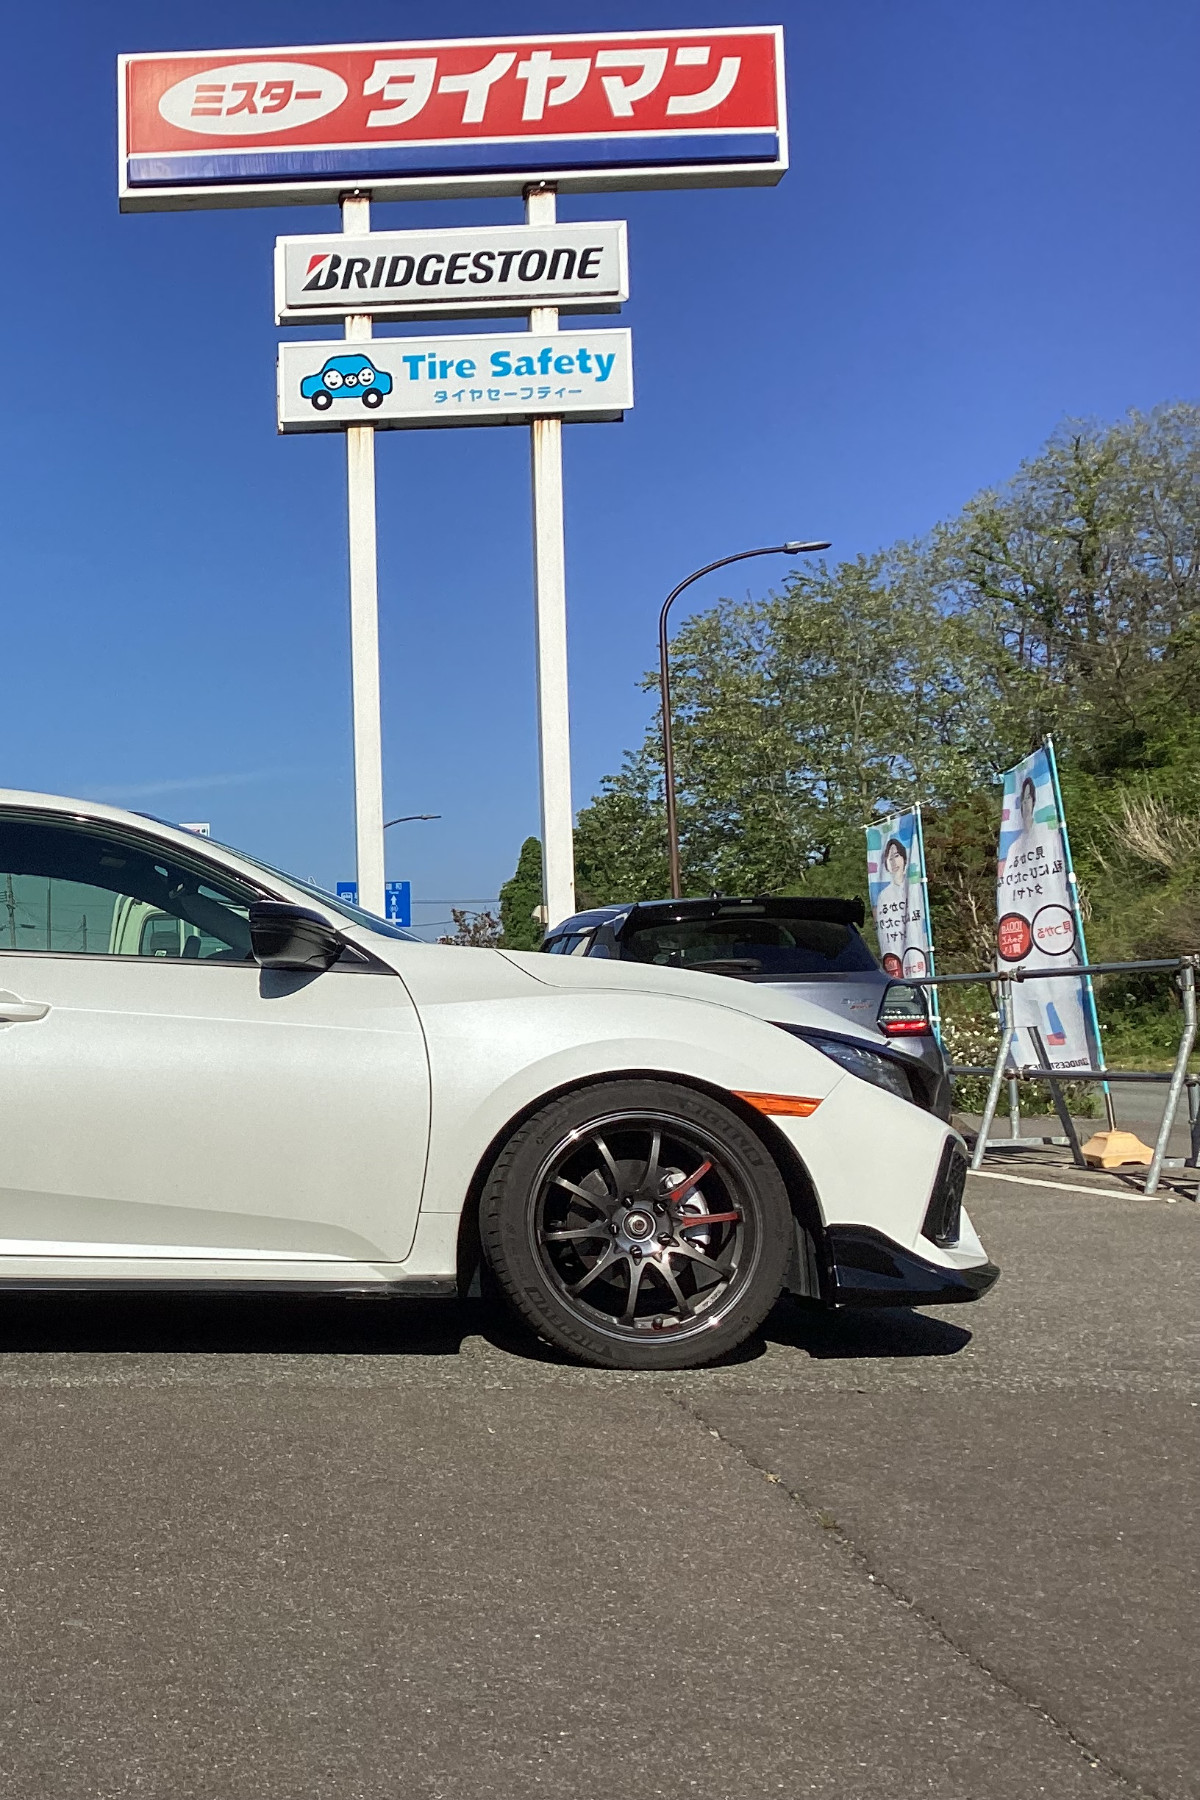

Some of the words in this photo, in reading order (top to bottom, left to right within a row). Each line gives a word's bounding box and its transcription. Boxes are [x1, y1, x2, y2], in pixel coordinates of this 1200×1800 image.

[190, 79, 323, 118] ミスター
[362, 46, 742, 128] タイヤマン
[301, 245, 604, 292] BRIDGESTONE
[402, 352, 477, 381] Tire
[490, 347, 616, 382] Safety
[433, 385, 582, 404] タイヤセーフティー
